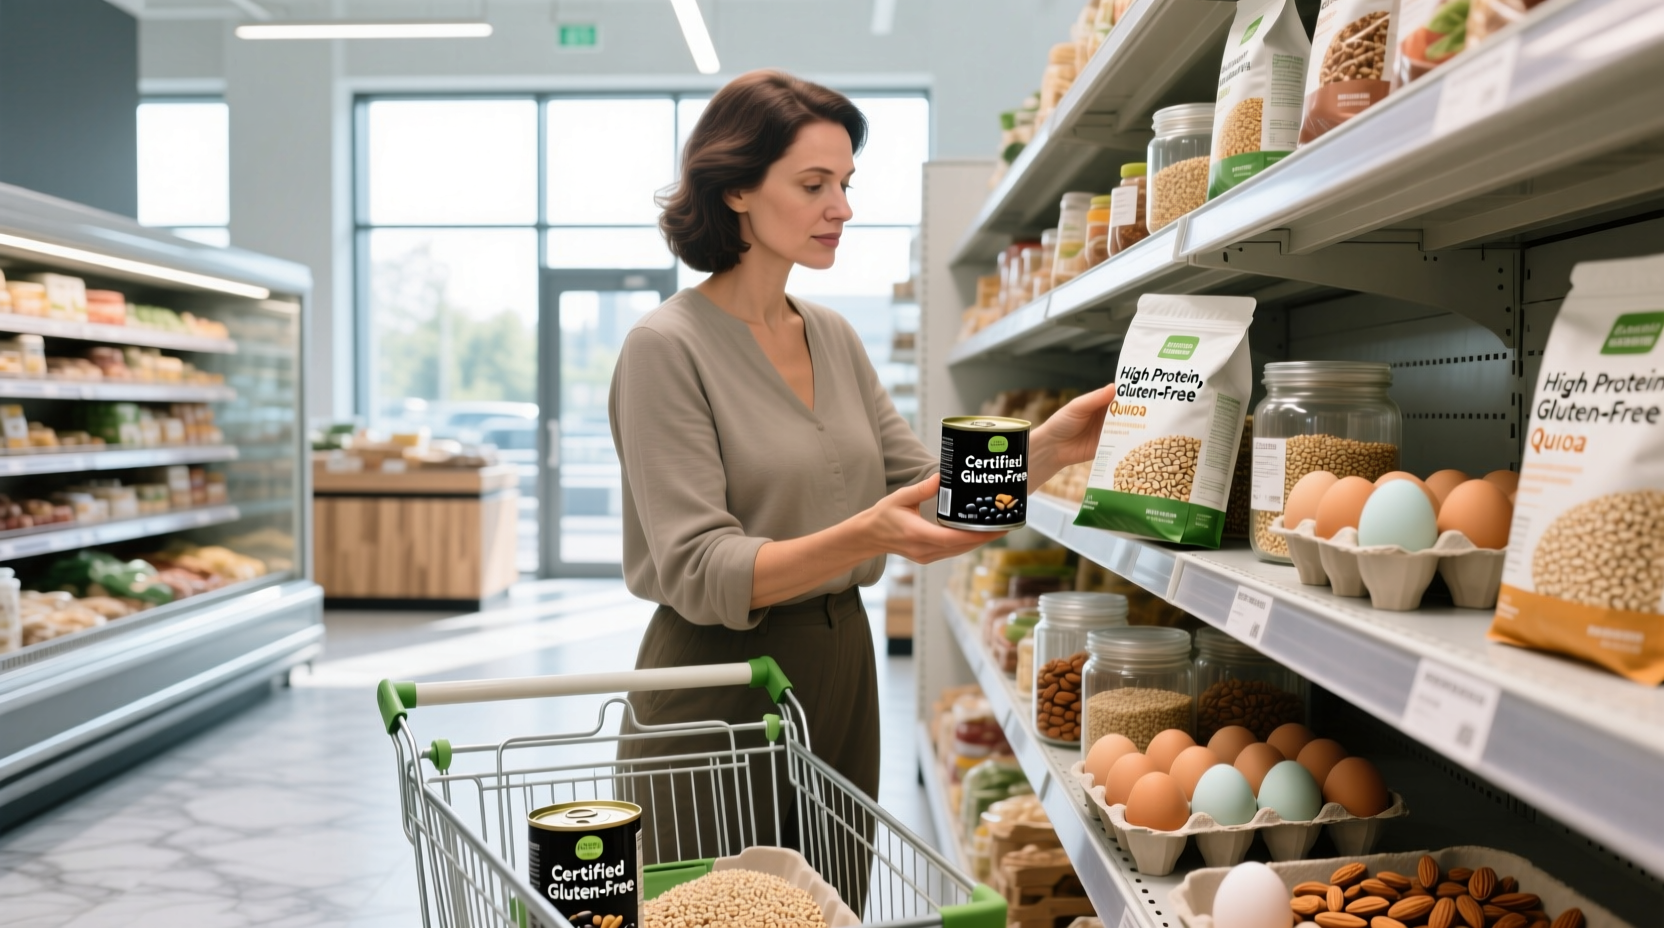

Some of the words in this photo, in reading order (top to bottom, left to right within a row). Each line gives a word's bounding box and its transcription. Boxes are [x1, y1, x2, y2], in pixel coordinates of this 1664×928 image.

[1120, 366, 1149, 384] High
[1151, 368, 1203, 389] Protein,
[1543, 371, 1588, 398] High
[1117, 383, 1196, 402] Gluten-Free
[1537, 399, 1661, 424] Gluten-Free
[965, 454, 1023, 469] Certified
[551, 859, 624, 882] Certified
[547, 879, 635, 900] Gluten-Free
